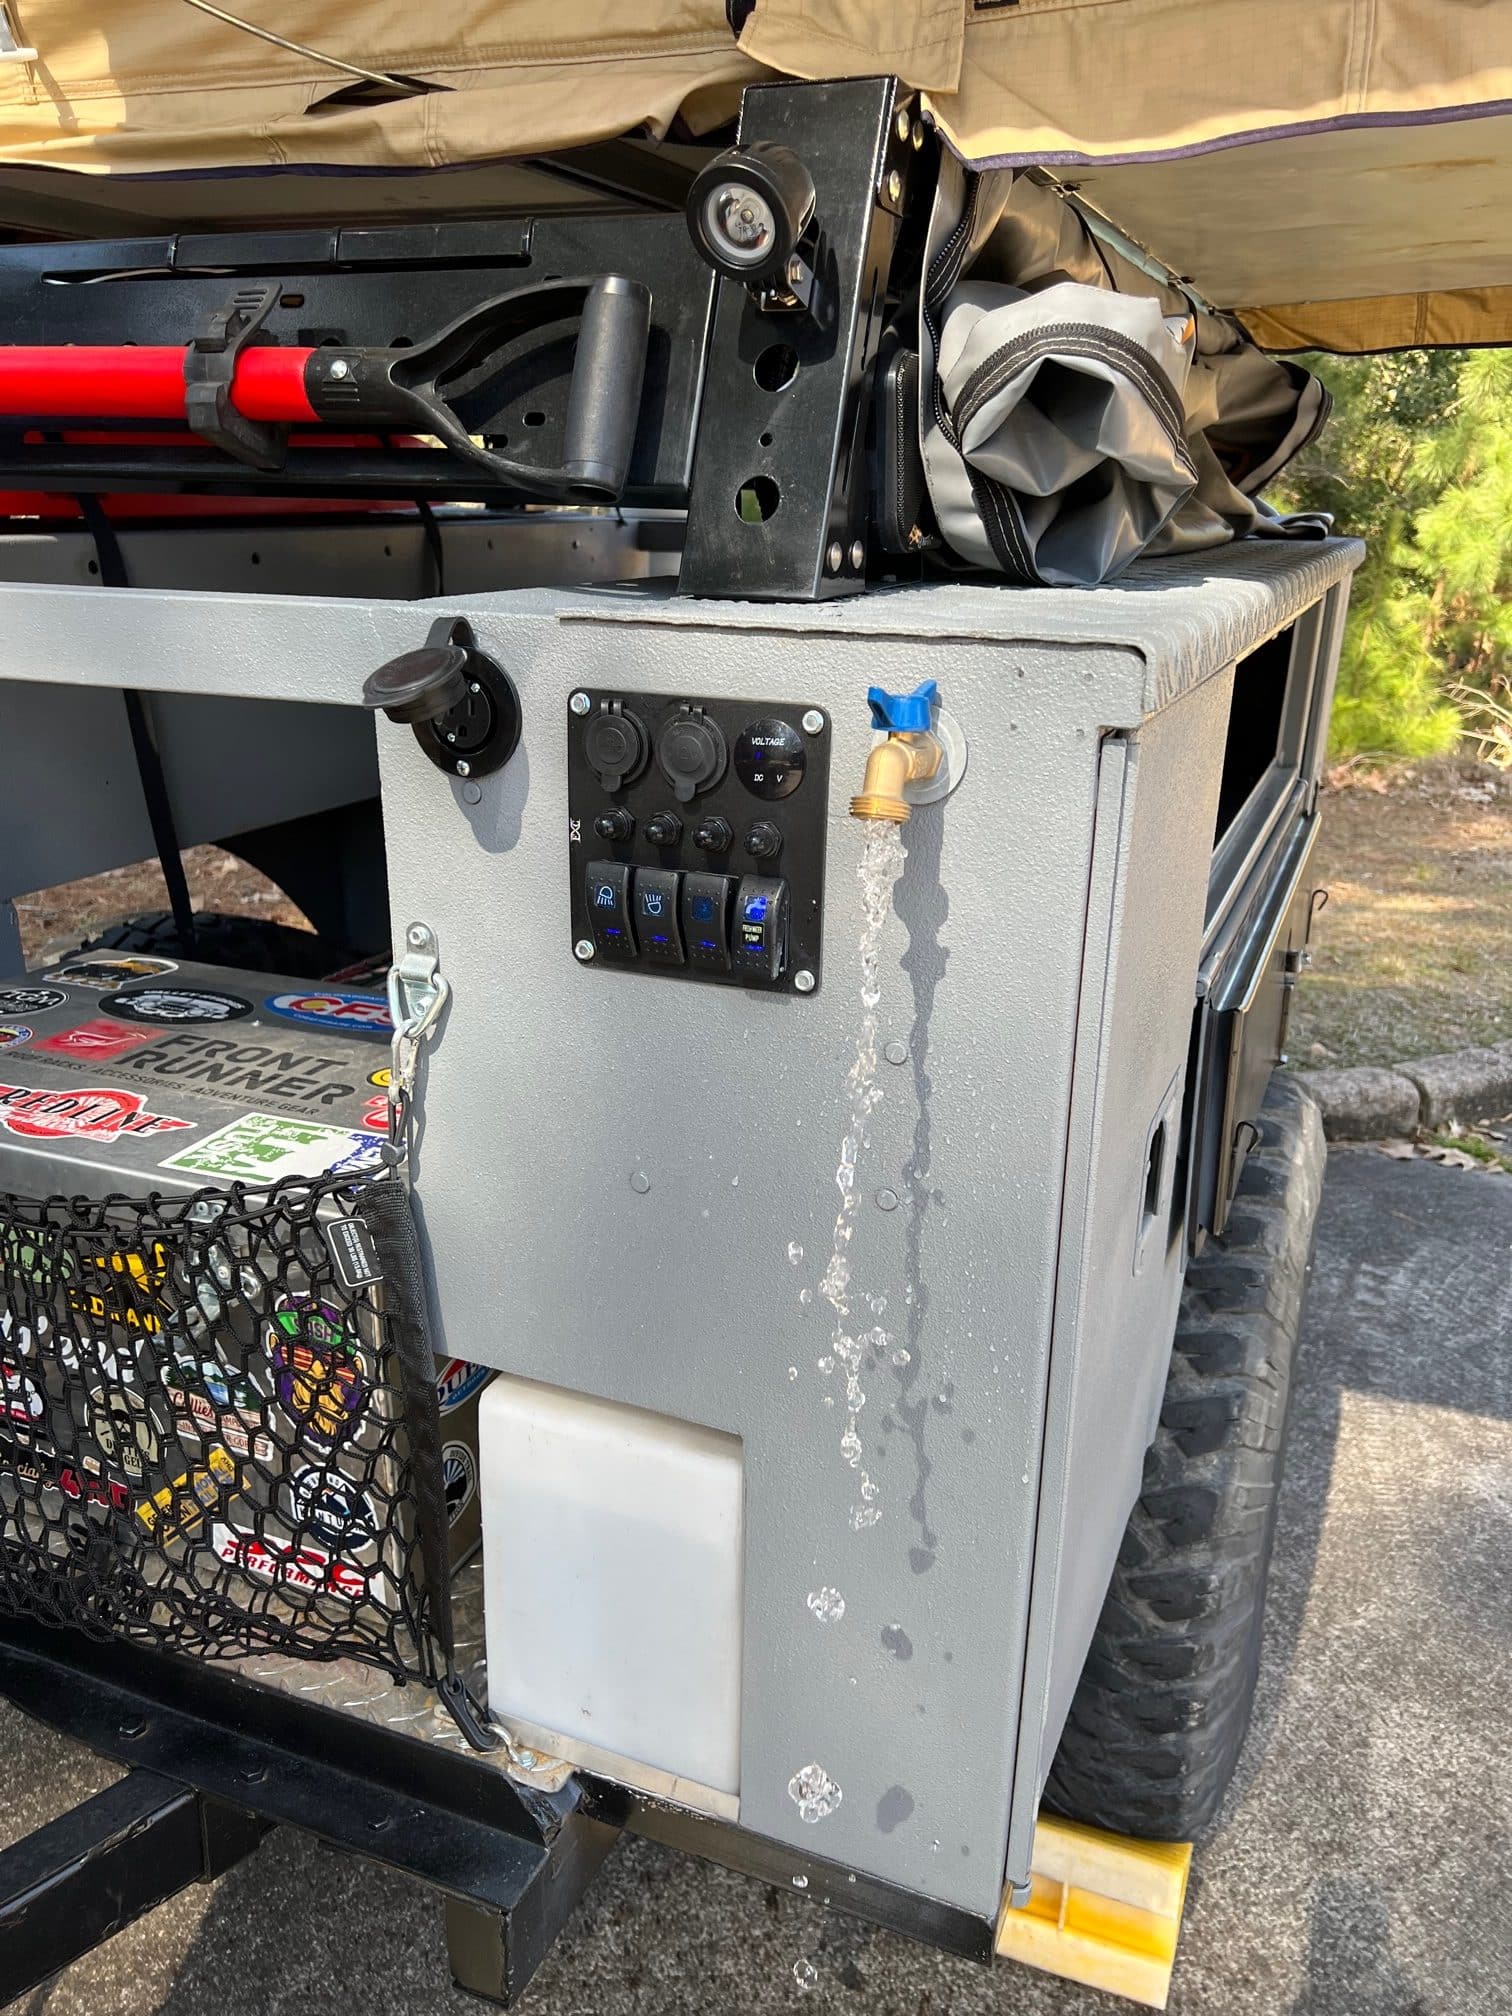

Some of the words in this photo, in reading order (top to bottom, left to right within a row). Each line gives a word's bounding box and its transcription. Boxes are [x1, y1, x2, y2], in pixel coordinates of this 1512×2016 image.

[751, 737, 786, 746] VOLTAGE
[753, 773, 764, 782] DC
[776, 774, 784, 783] V
[113, 1050, 356, 1105] RUNNER
[154, 1034, 349, 1076] FRONT
[43, 1055, 87, 1071] RACKS
[94, 1067, 187, 1091] ACCESSORIES
[190, 1087, 280, 1107] ADVENTURE
[277, 1102, 320, 1116] GEAR
[0, 1088, 172, 1134] REDLINE
[221, 1547, 364, 1598] PRFORMNCE
